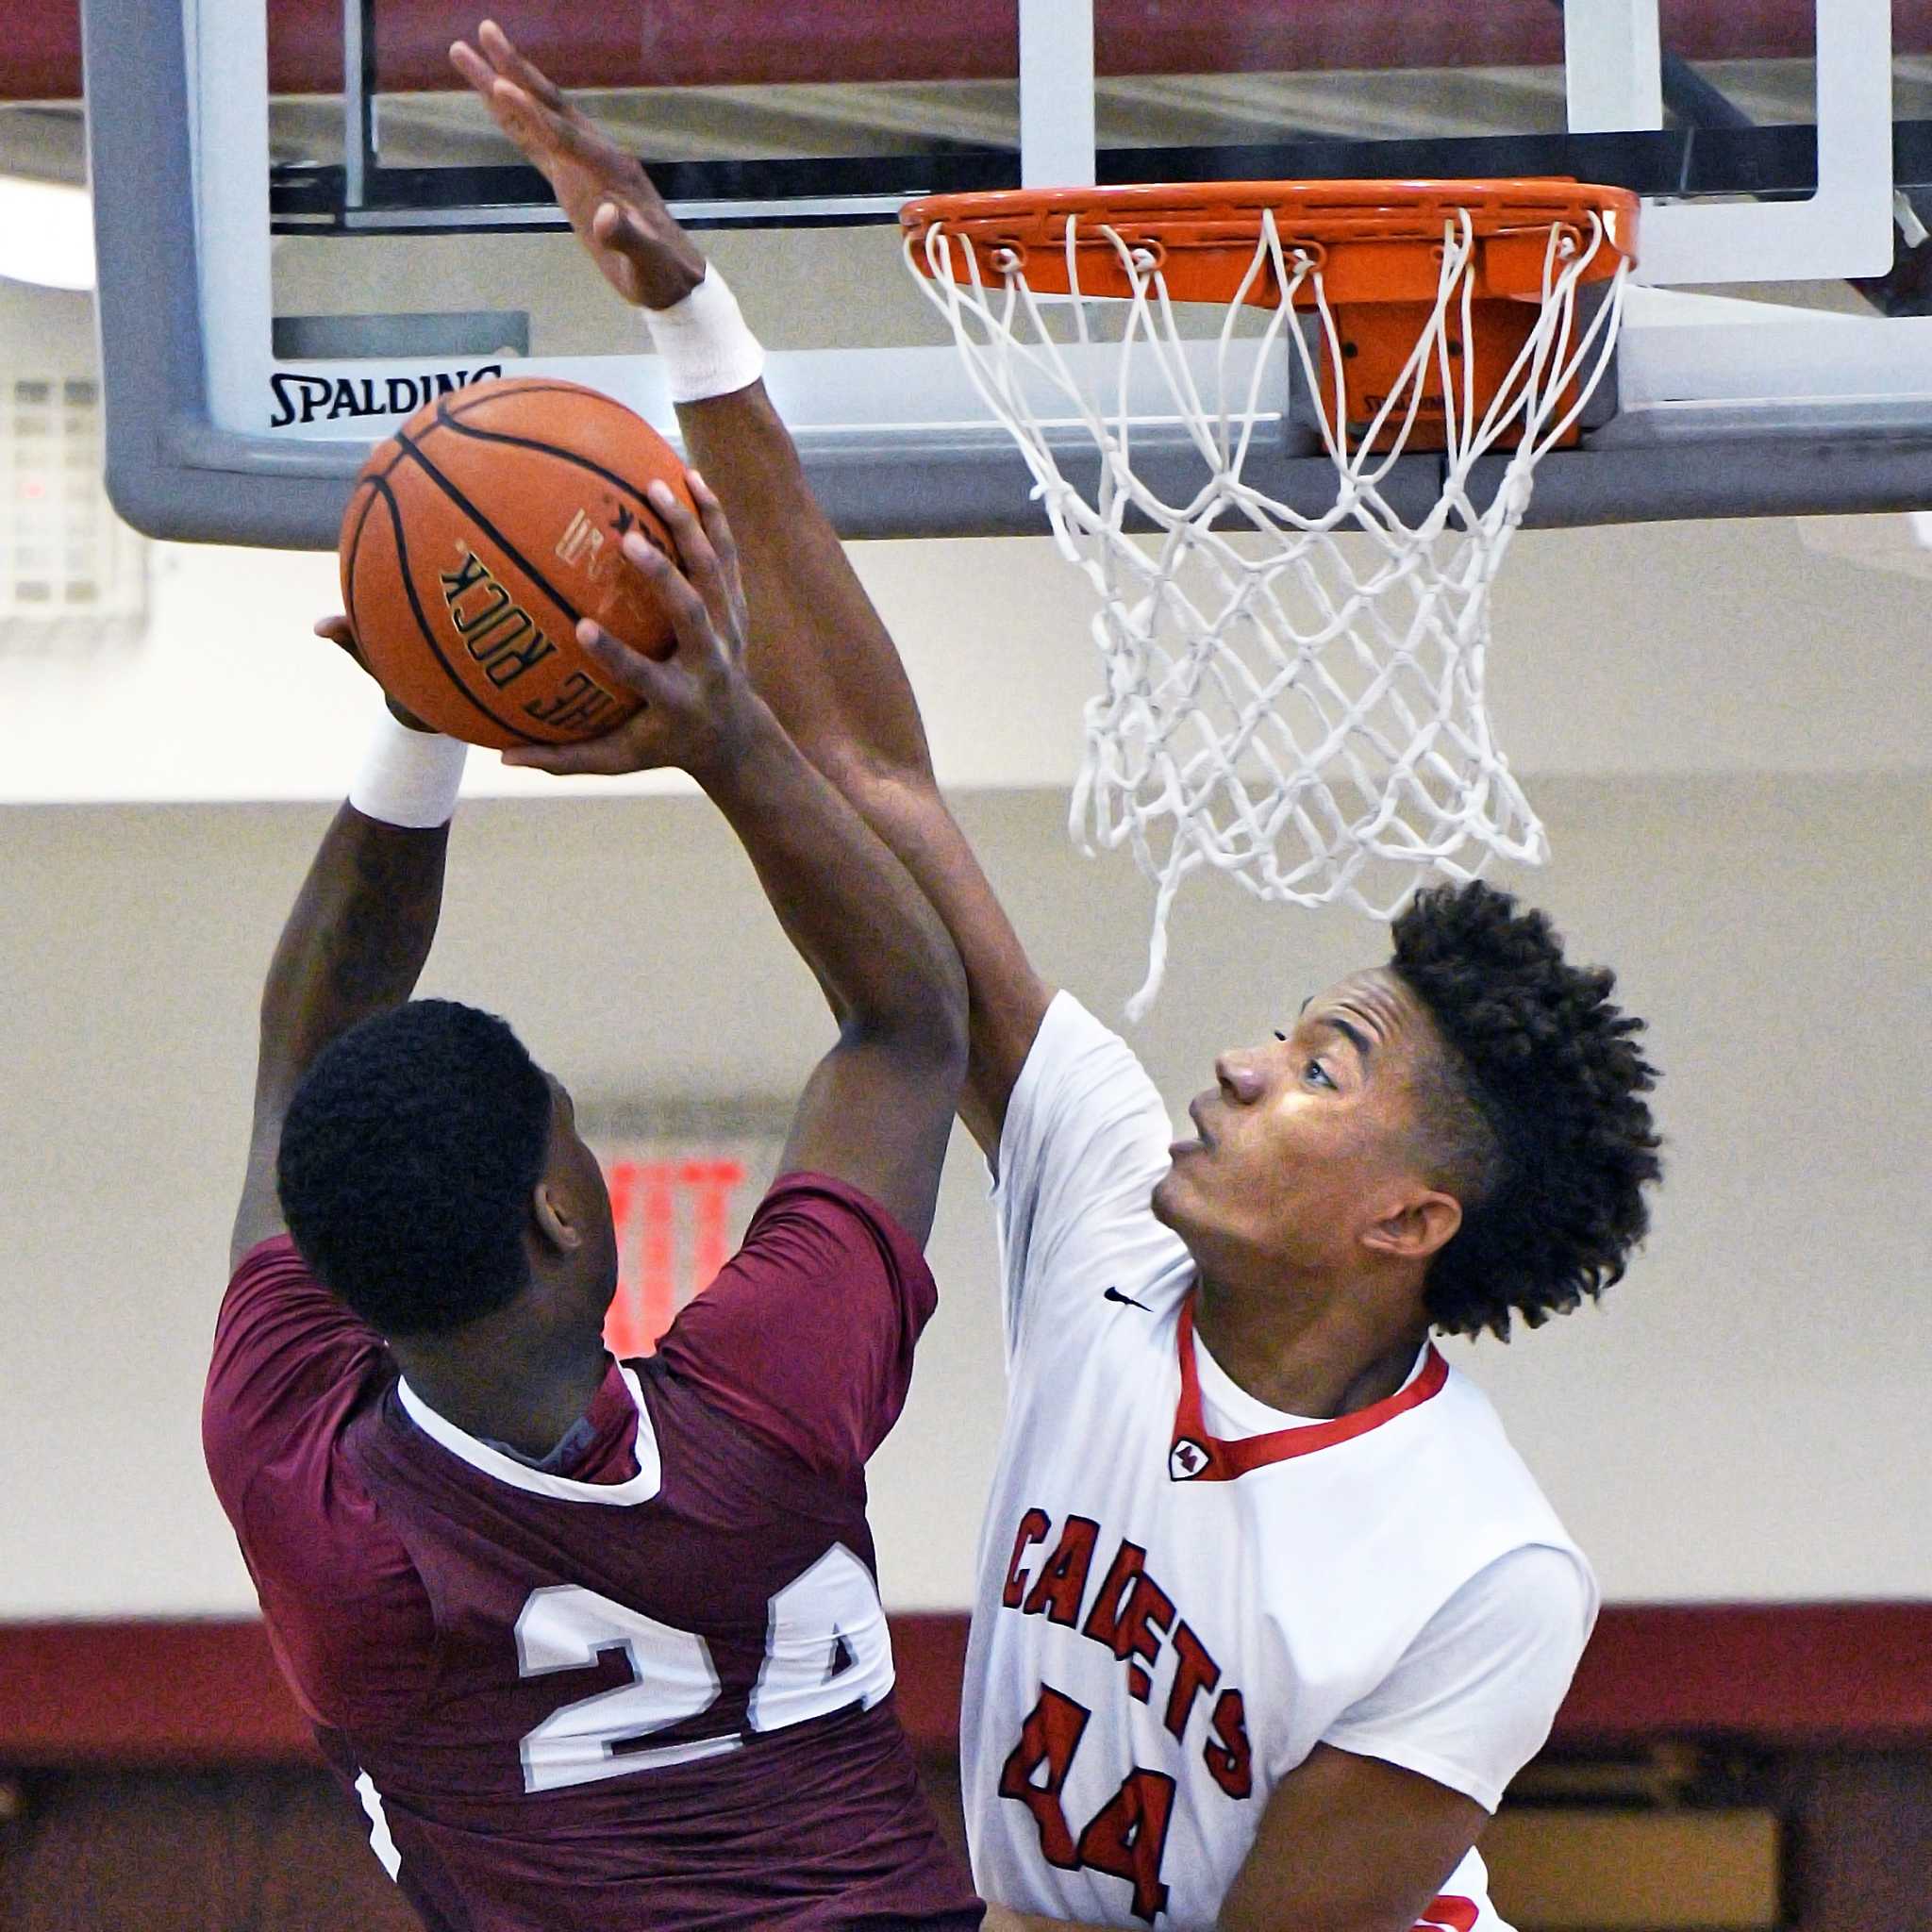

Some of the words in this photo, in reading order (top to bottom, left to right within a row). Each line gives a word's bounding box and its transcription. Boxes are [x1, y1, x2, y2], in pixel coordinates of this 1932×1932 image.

[441, 552, 558, 689] ROCK
[523, 670, 618, 727] HE
[513, 1541, 895, 1793] 24
[998, 1682, 1176, 1924] 44
